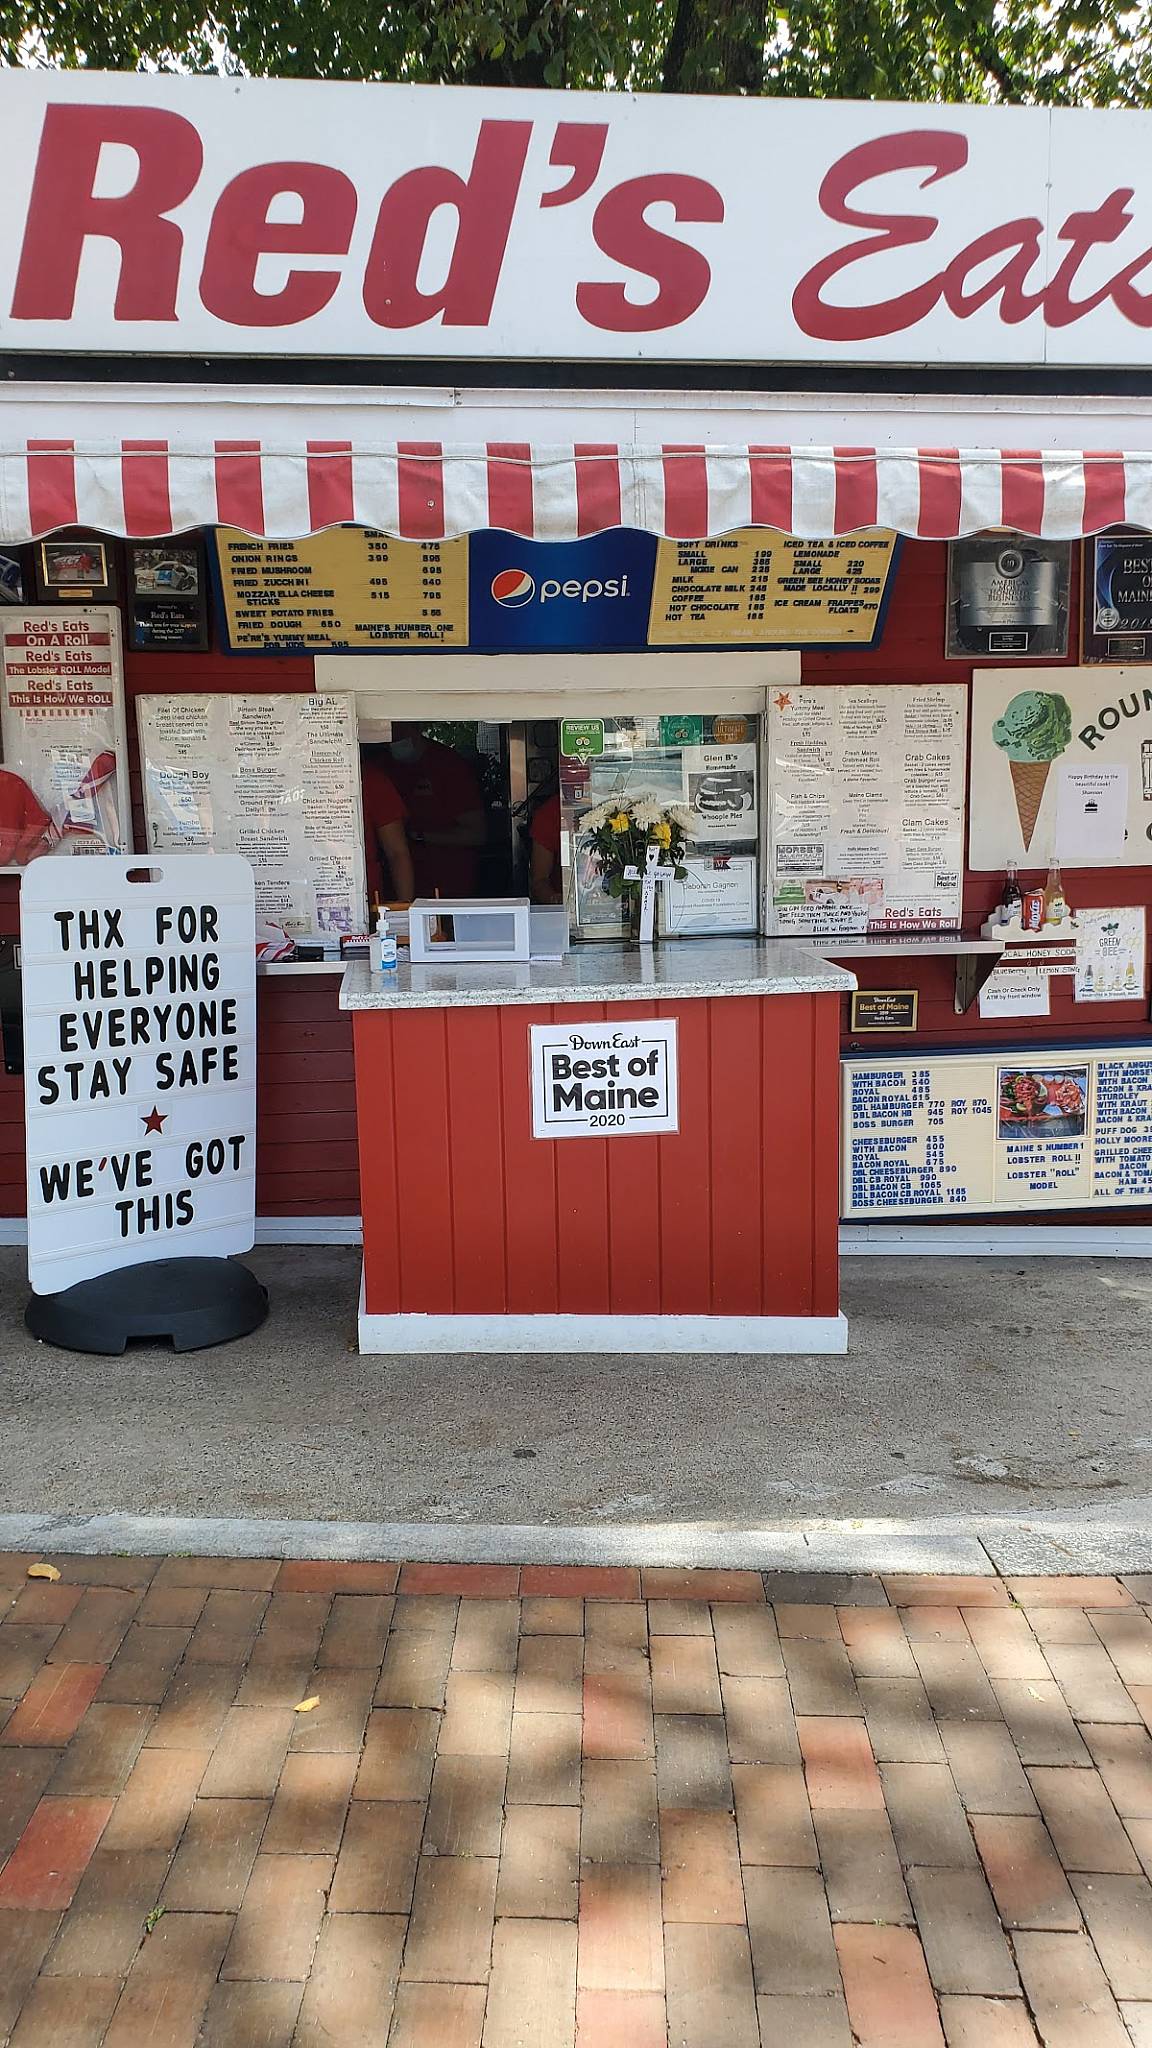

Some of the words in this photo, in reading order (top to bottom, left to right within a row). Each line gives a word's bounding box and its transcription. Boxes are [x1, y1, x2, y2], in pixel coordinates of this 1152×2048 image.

[9, 102, 725, 332] Red's
[232, 555, 261, 563] ONION
[232, 567, 258, 575] FRIED
[262, 566, 312, 574] MUSHROOM
[793, 567, 821, 575] LARGE
[233, 579, 258, 587] FRIED
[541, 575, 627, 603] pepsi
[672, 585, 722, 593] CHOCOLATE
[247, 598, 280, 606] STICKS
[827, 599, 864, 607] FRAPPES
[236, 610, 266, 618] SWEET
[307, 609, 333, 617] FRIES
[24, 621, 57, 632] Red's
[63, 621, 89, 631] Eats
[355, 624, 390, 632] MAINE'S
[27, 636, 45, 646] On
[51, 636, 60, 645] A
[64, 634, 88, 645] Roll
[370, 632, 410, 640] LOBSTER
[418, 631, 444, 642] ROLL!
[26, 650, 60, 661] Red's
[65, 651, 92, 661] Eats
[28, 680, 61, 690] Red's
[67, 680, 93, 690] Eats
[11, 695, 30, 703] This
[44, 695, 66, 703] How
[69, 695, 84, 703] We
[87, 695, 111, 703] ROLL
[309, 698, 324, 706] Big
[192, 771, 209, 779] Boy
[885, 907, 914, 917] Red's
[919, 907, 941, 916] Eats
[53, 908, 124, 952] THX
[155, 905, 219, 946] FOR
[870, 921, 886, 929] This
[890, 921, 897, 929] Is
[922, 920, 936, 928] We
[1099, 938, 1121, 947] GREEN
[1103, 948, 1118, 956] BEE
[74, 952, 220, 1001] HELPING
[59, 999, 237, 1053] EVERYONE
[552, 1054, 620, 1080] Best
[627, 1049, 658, 1076] of
[38, 1057, 132, 1104] STAY
[156, 1045, 239, 1090] SAFE
[853, 1072, 903, 1080] HAMBURGER
[553, 1080, 659, 1112] Maine
[589, 1114, 625, 1127] 2020
[852, 1137, 917, 1145] CHEESEBURGER
[1008, 1156, 1045, 1164] LOBSTER
[40, 1149, 152, 1203] WE'VE
[185, 1135, 245, 1179] GOT
[1008, 1171, 1046, 1179] LOBSTER
[1050, 1168, 1079, 1177] "ROLL"
[1030, 1182, 1058, 1190] MODEL
[877, 1197, 943, 1206] CHEESEBURGER
[115, 1189, 194, 1237] THIS
